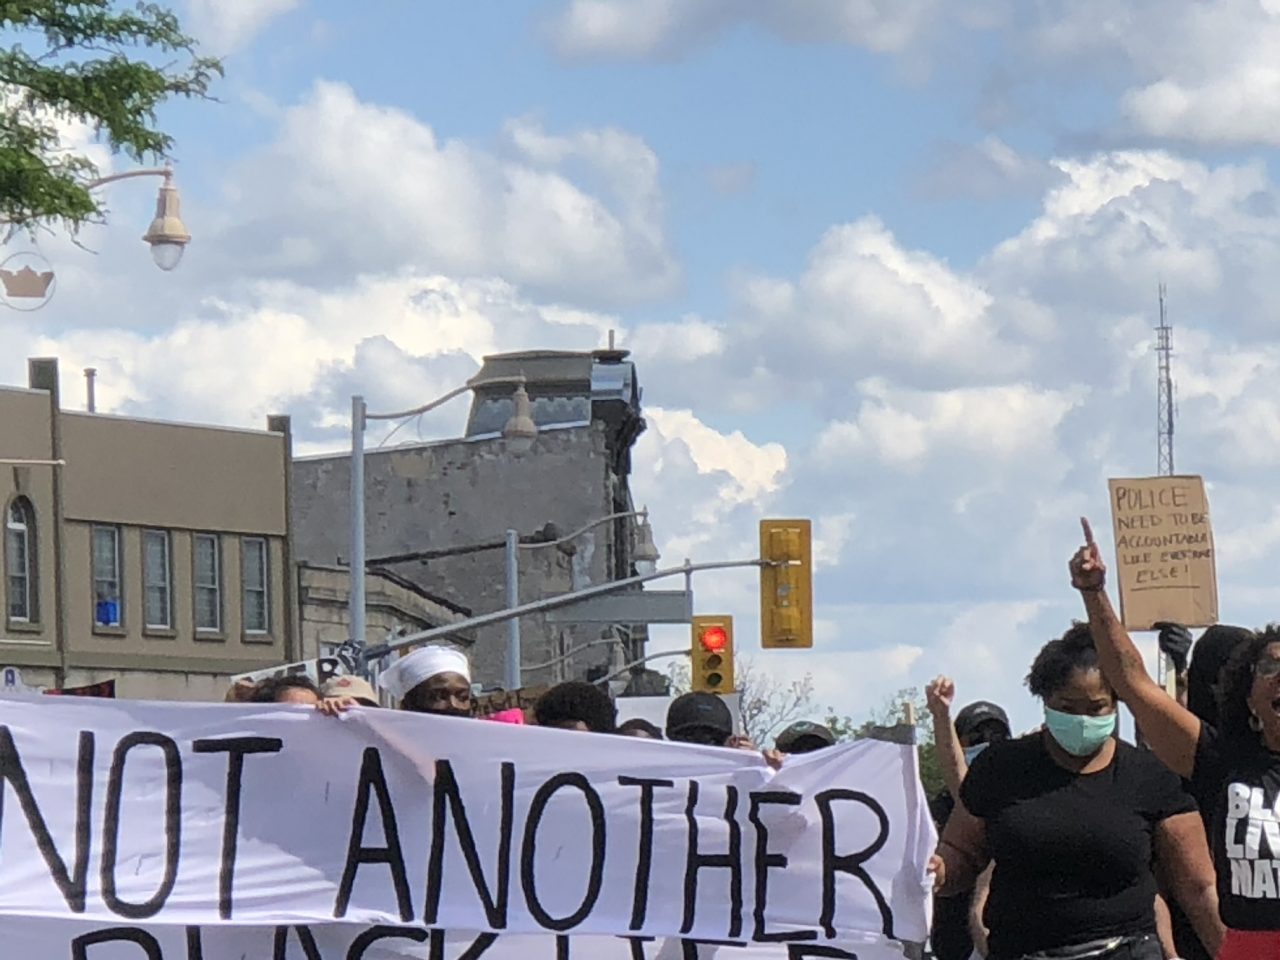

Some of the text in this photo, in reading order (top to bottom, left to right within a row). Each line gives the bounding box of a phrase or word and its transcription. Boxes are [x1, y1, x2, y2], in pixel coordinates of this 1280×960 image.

[1116, 486, 1190, 511] POLICE
[1117, 514, 1162, 531] NEED
[0, 725, 895, 940] NOT ANOTHER
